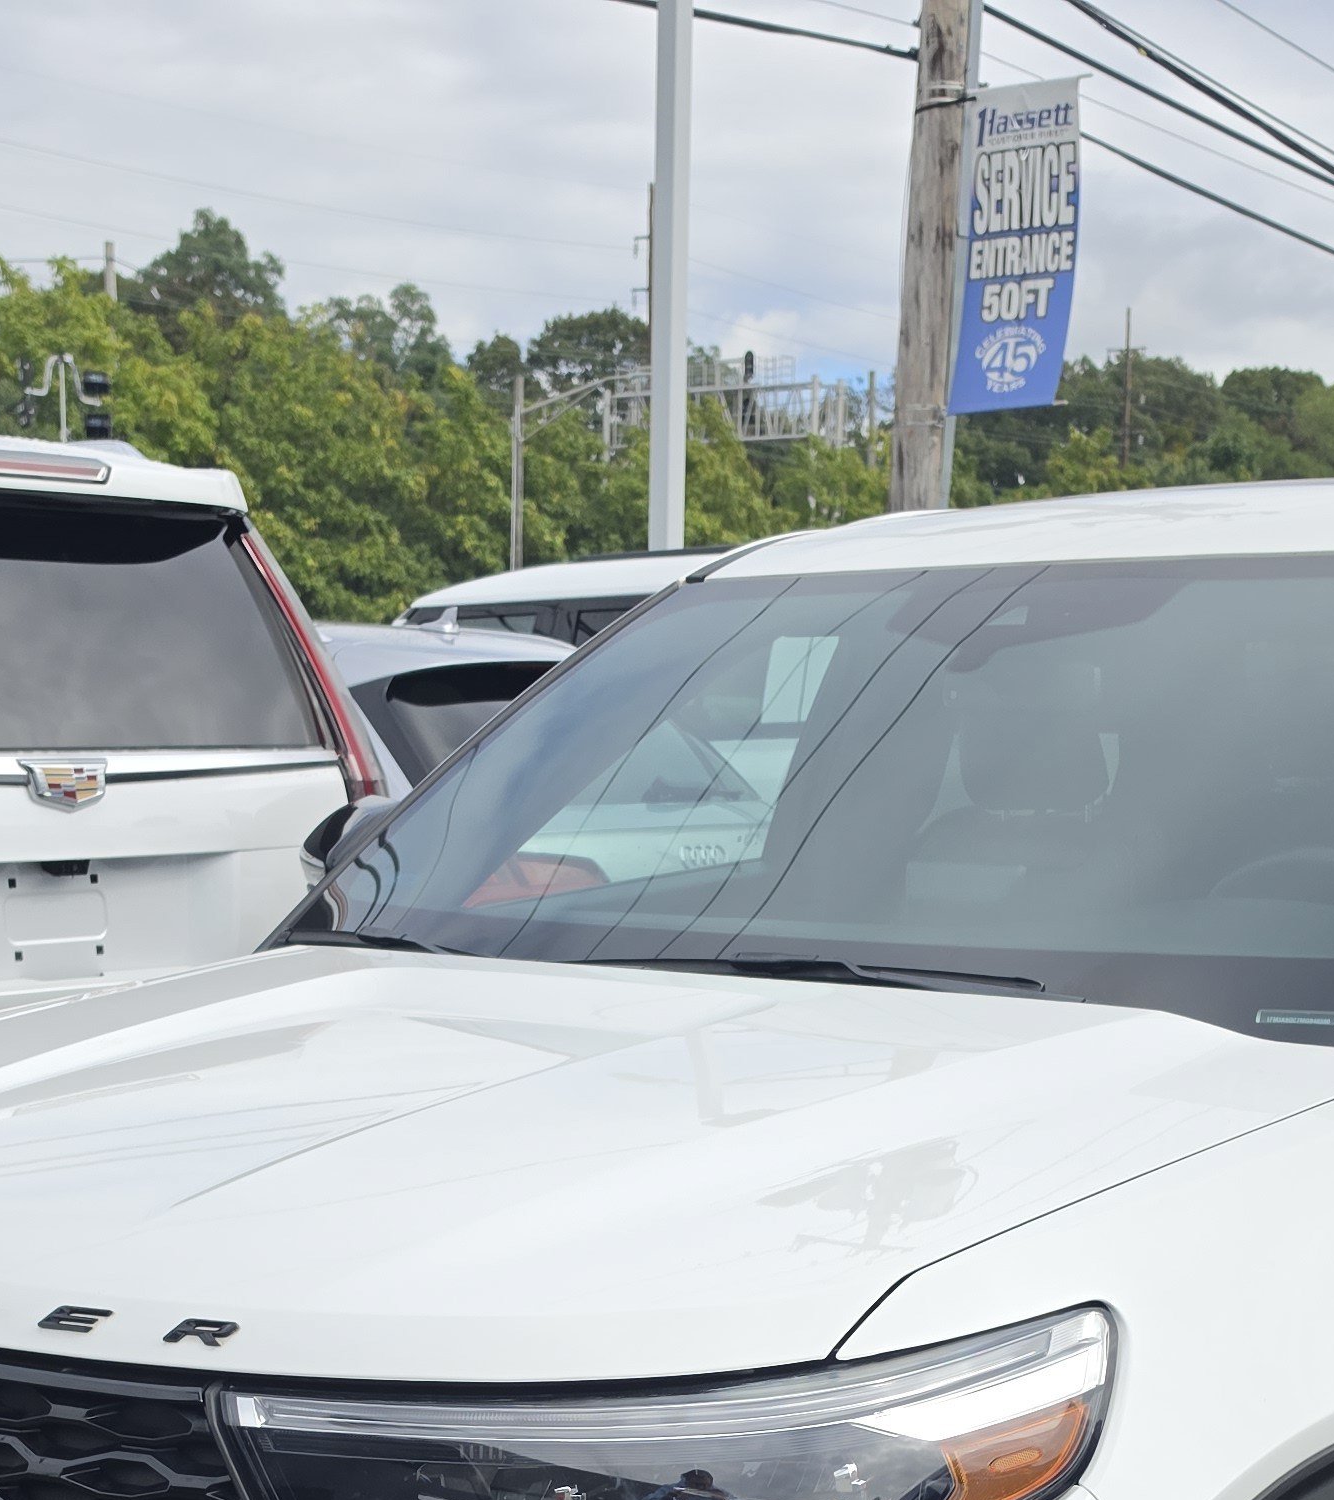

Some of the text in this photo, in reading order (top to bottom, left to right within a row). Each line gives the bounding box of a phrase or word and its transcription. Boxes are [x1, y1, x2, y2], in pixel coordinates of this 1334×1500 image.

[973, 141, 1075, 236] SERVICE
[969, 230, 1075, 280] ENTRANCE
[981, 277, 1055, 323] 50FT
